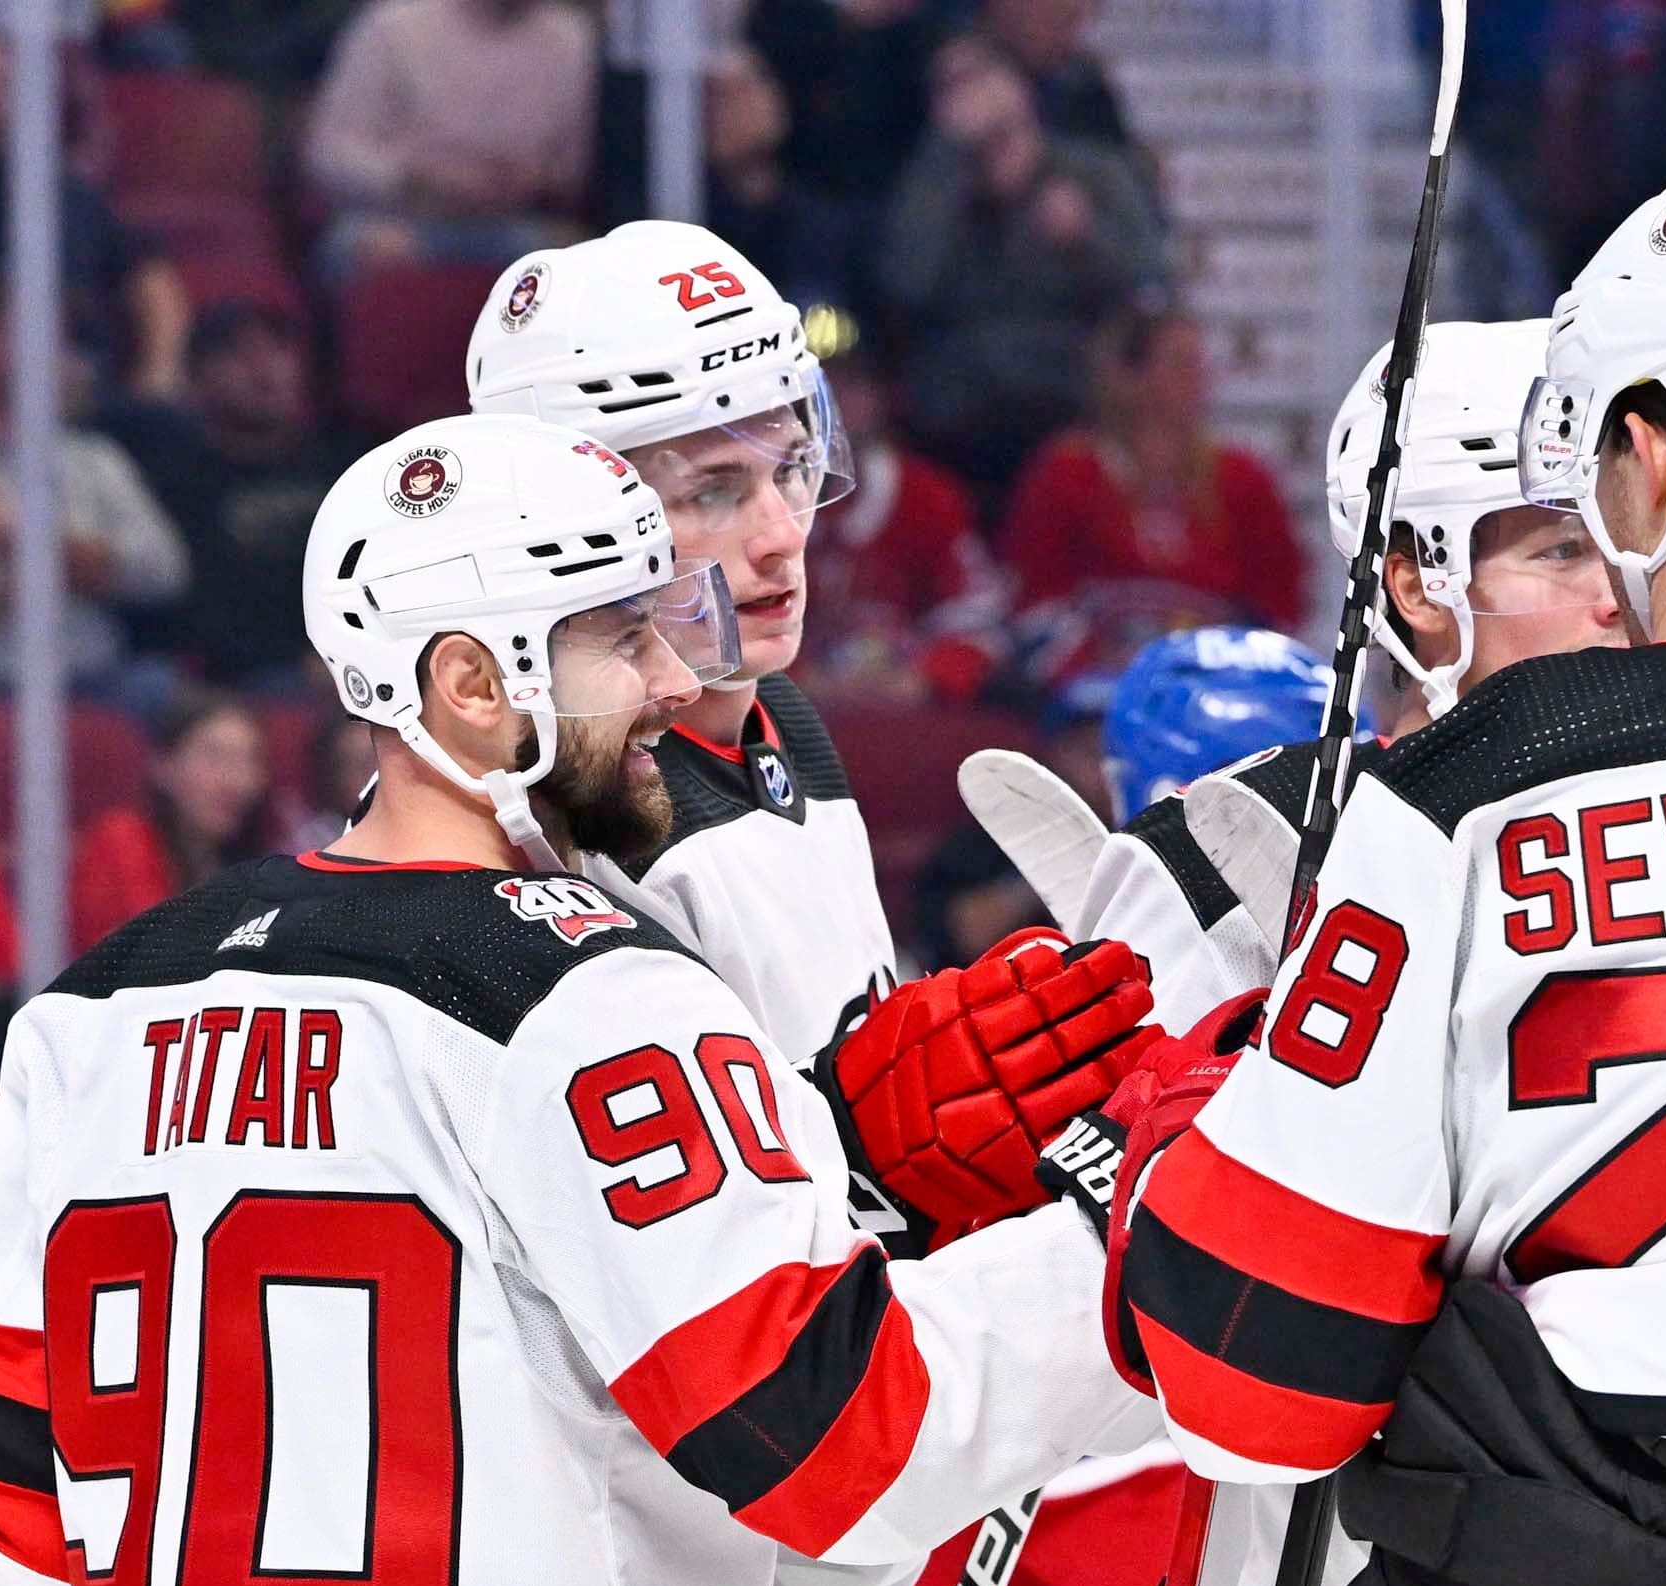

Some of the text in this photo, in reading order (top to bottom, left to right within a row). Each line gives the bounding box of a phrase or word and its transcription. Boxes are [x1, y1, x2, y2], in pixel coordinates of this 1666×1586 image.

[658, 261, 746, 312] 25
[700, 333, 780, 373] CCM
[1543, 444, 1572, 454] BAUER
[389, 480, 458, 515] COFFEE HOUSE
[517, 883, 616, 920] 40
[144, 1006, 343, 1157] TATAR
[566, 1033, 813, 1230] 90
